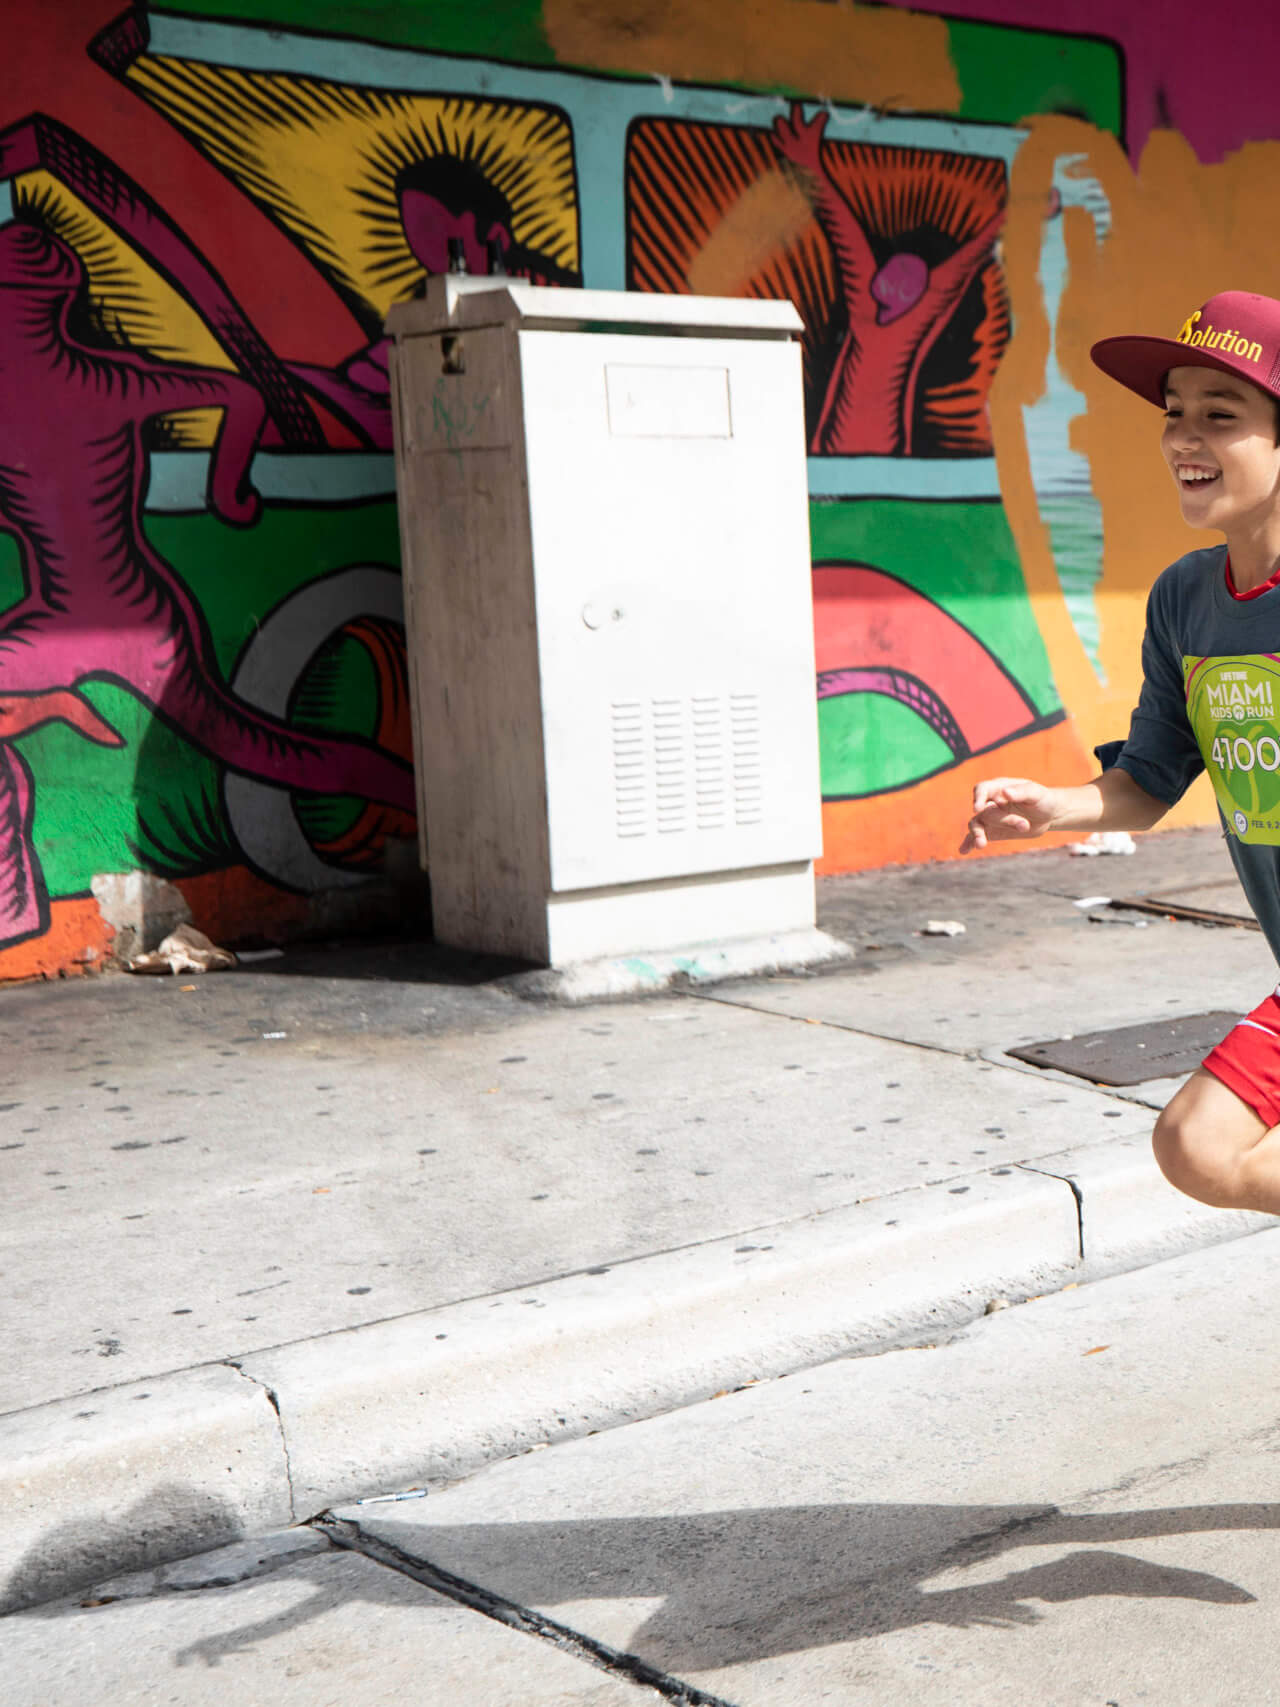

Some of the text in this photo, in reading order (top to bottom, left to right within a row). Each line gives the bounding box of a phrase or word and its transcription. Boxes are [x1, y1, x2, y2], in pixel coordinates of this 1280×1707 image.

[1176, 310, 1263, 363] Solution
[1206, 681, 1273, 705] MIAMI
[1209, 705, 1275, 719] KIDS RUN
